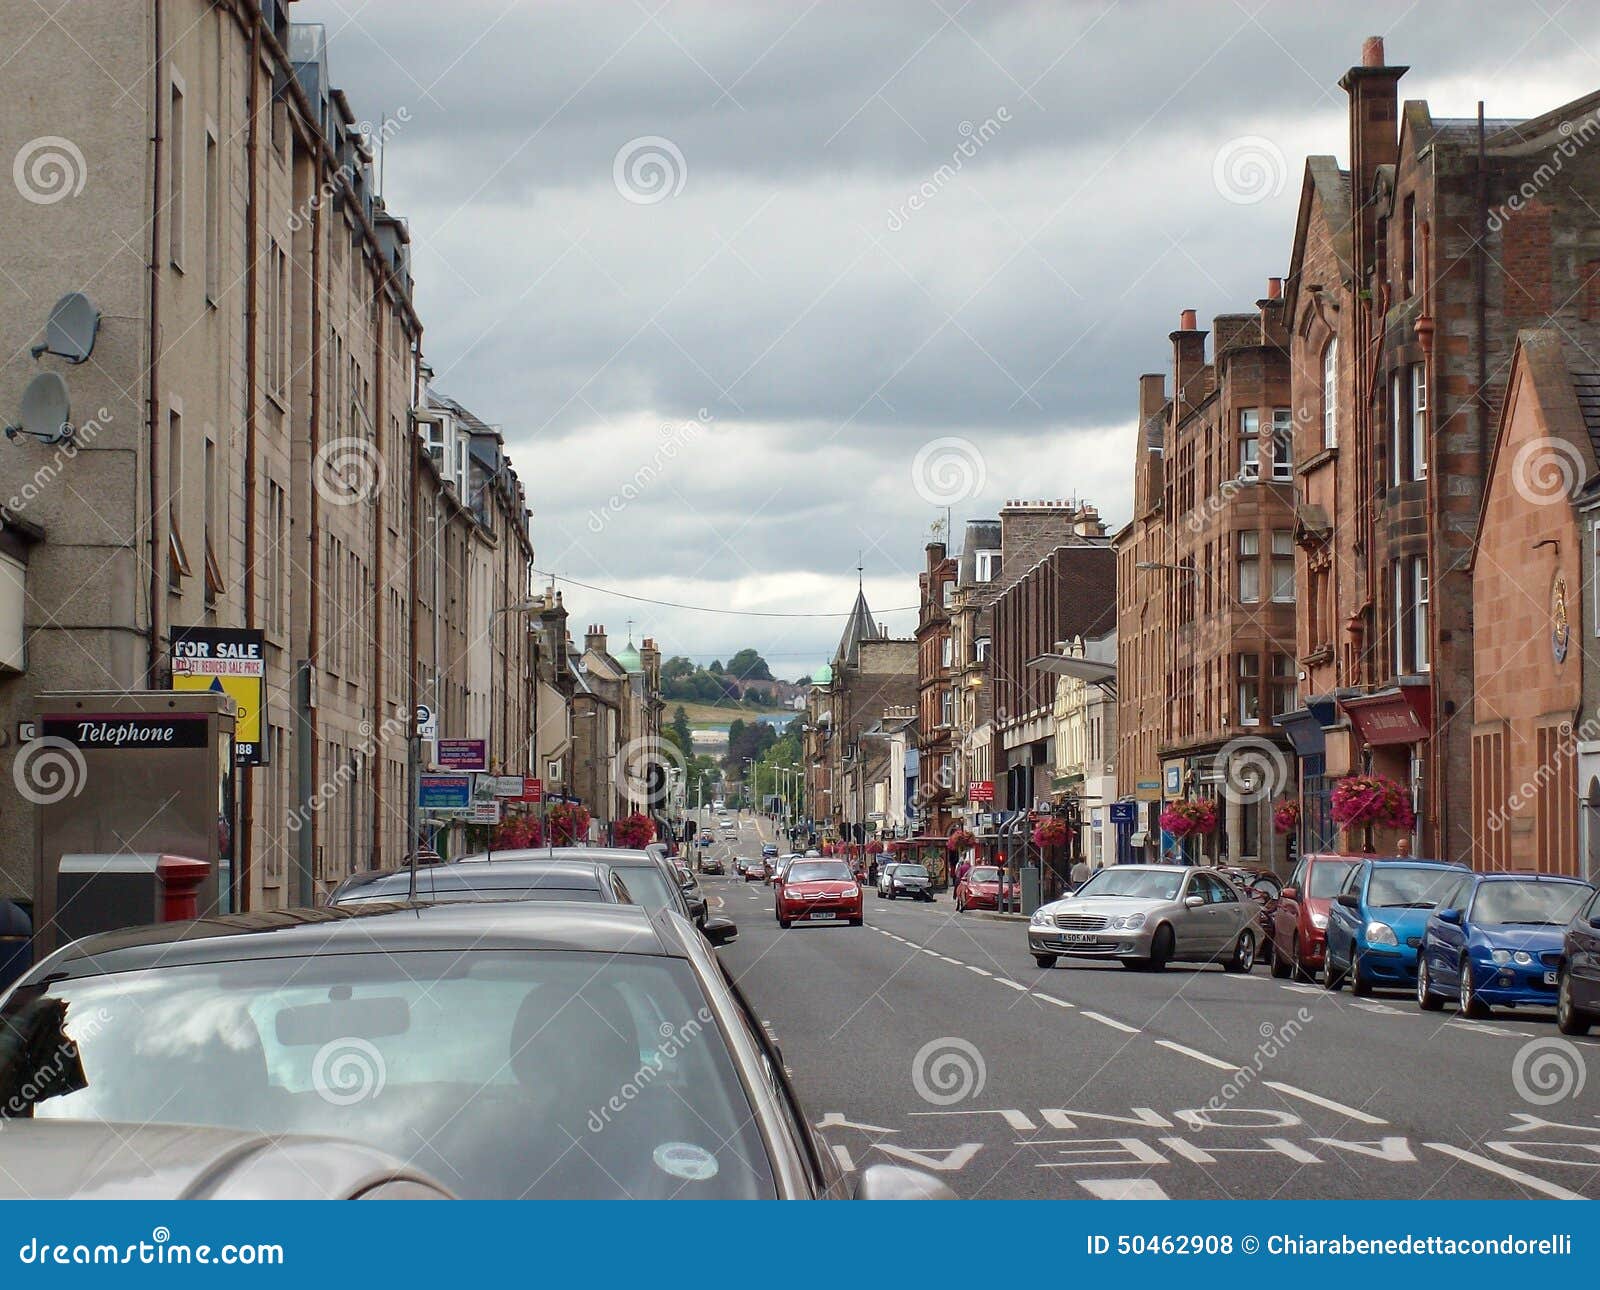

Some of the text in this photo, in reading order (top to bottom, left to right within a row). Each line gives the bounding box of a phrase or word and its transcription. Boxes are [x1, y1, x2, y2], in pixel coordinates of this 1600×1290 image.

[175, 641, 259, 658] FOR SALE
[77, 722, 174, 743] Telephone
